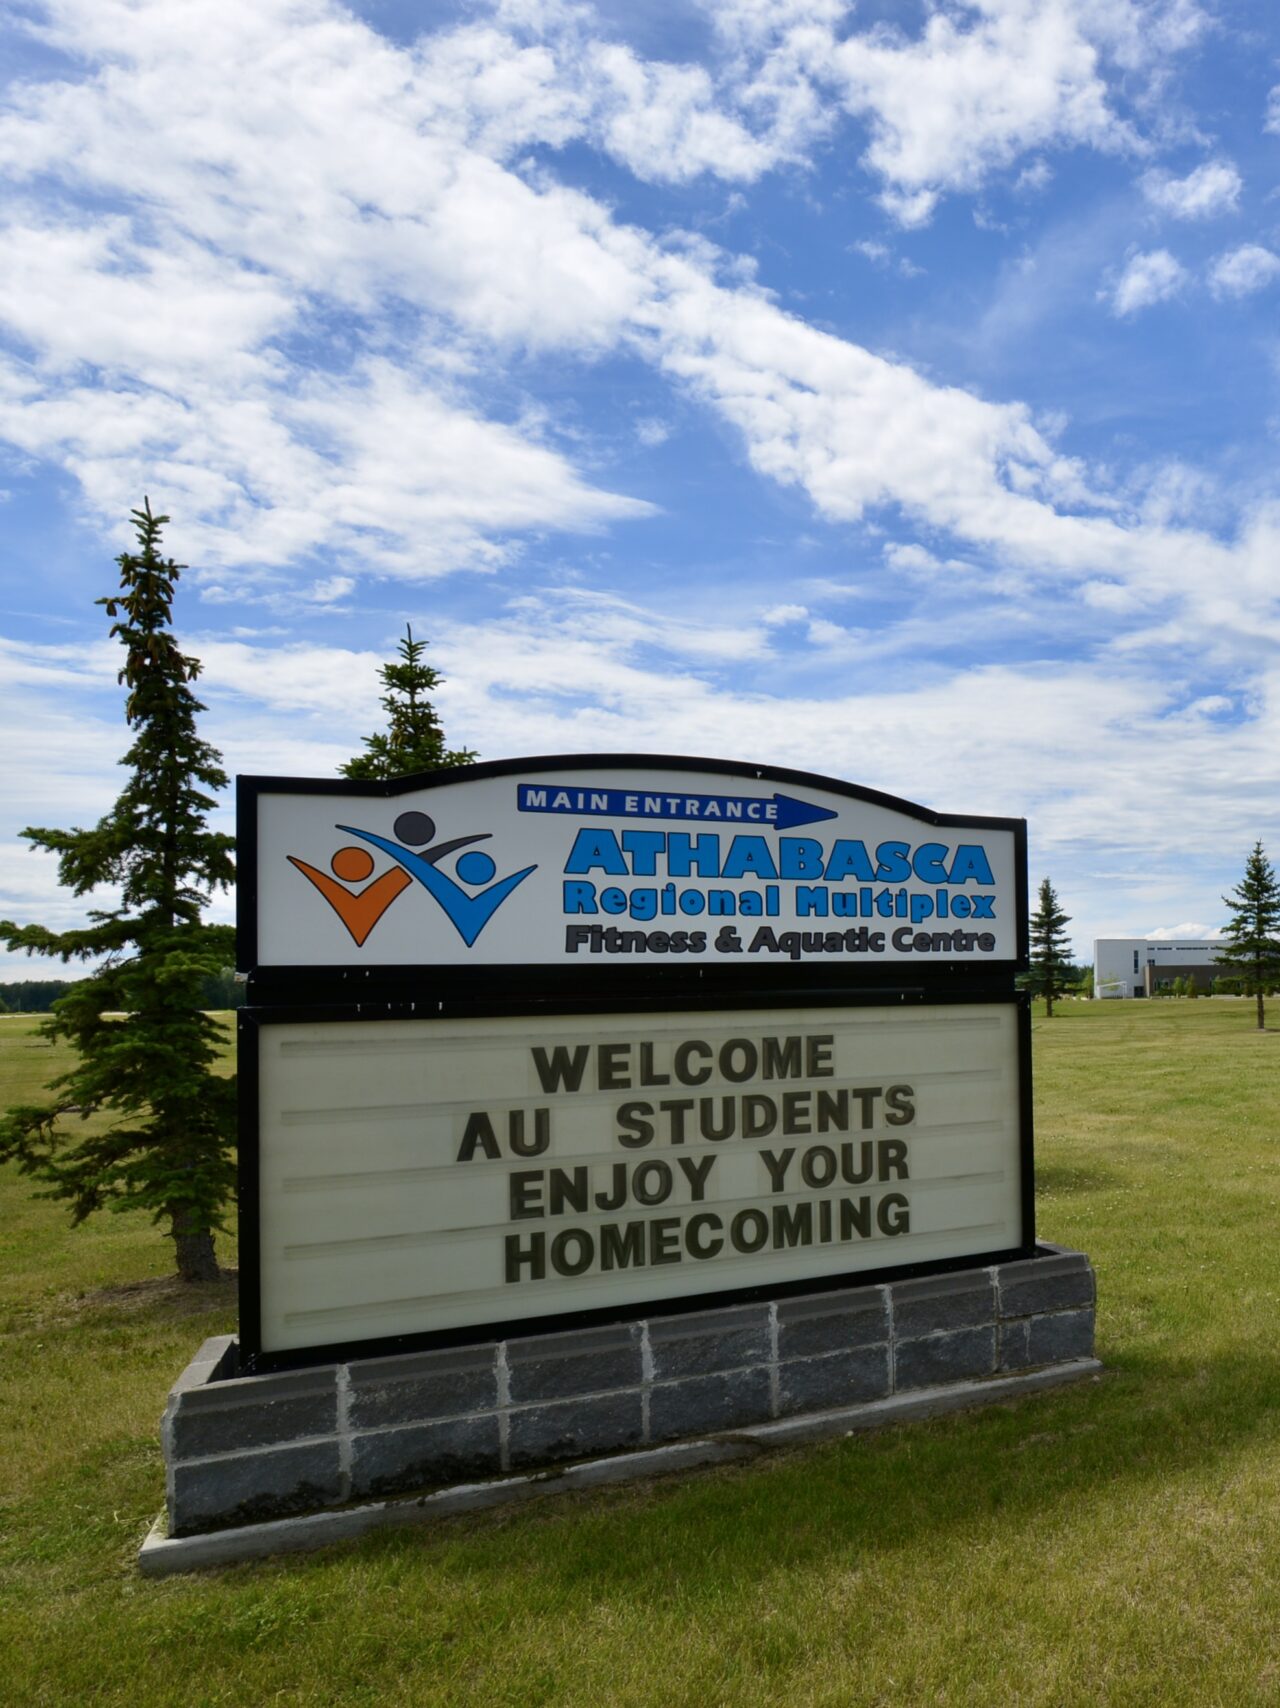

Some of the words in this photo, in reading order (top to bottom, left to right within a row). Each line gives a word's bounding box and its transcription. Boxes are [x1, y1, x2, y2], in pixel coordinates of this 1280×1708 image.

[526, 790, 608, 810] MAIN
[625, 796, 778, 820] ENTRANCE
[563, 828, 996, 885] ATHABASCA
[563, 880, 780, 922] Regional
[796, 885, 997, 924] Multiplex
[565, 924, 708, 953] Fitness
[714, 925, 743, 953] &
[748, 926, 886, 960] Aquatic
[892, 926, 996, 953] Centre
[531, 1034, 835, 1094] WELCOME
[456, 1107, 551, 1162] AU
[616, 1084, 916, 1149] STUDENTS
[509, 1154, 717, 1221] ENJOY
[759, 1139, 910, 1193] YOUR
[504, 1193, 911, 1284] HOMECOMING
